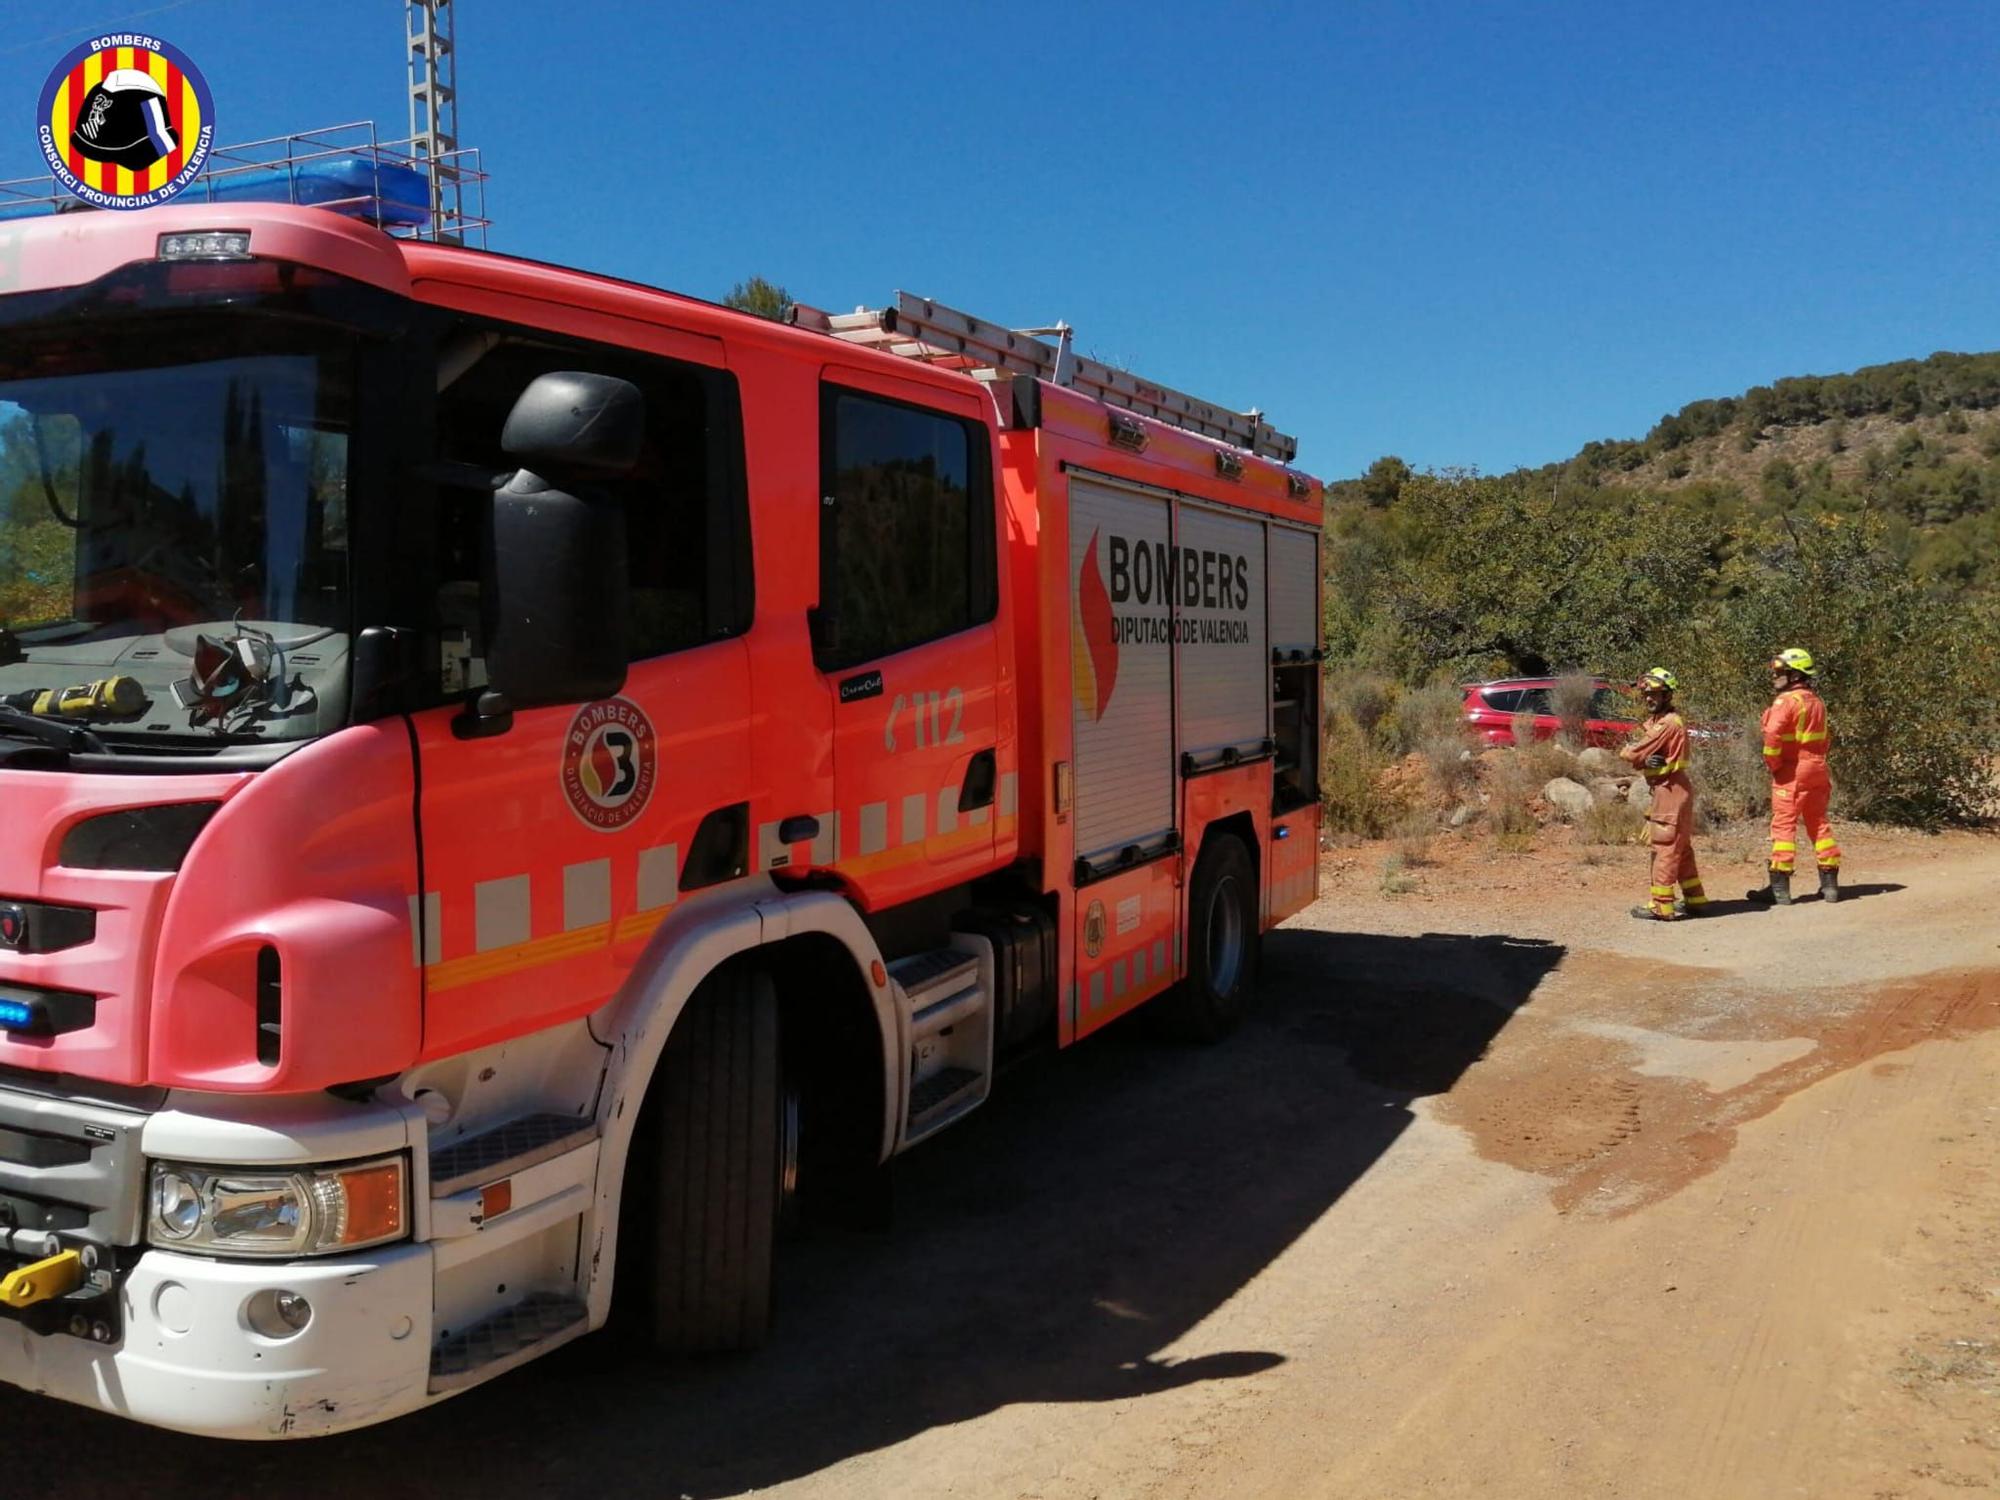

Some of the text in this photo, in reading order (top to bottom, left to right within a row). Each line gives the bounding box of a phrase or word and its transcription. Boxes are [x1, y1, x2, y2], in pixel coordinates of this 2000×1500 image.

[1109, 535, 1249, 611] BOMBERS
[1182, 618, 1198, 644] DE
[1200, 619, 1249, 645] VALENCIA
[572, 704, 647, 745] BOMBERS
[912, 687, 965, 751] 112
[608, 812, 621, 823] DE
[623, 761, 652, 815] VALENCIA
